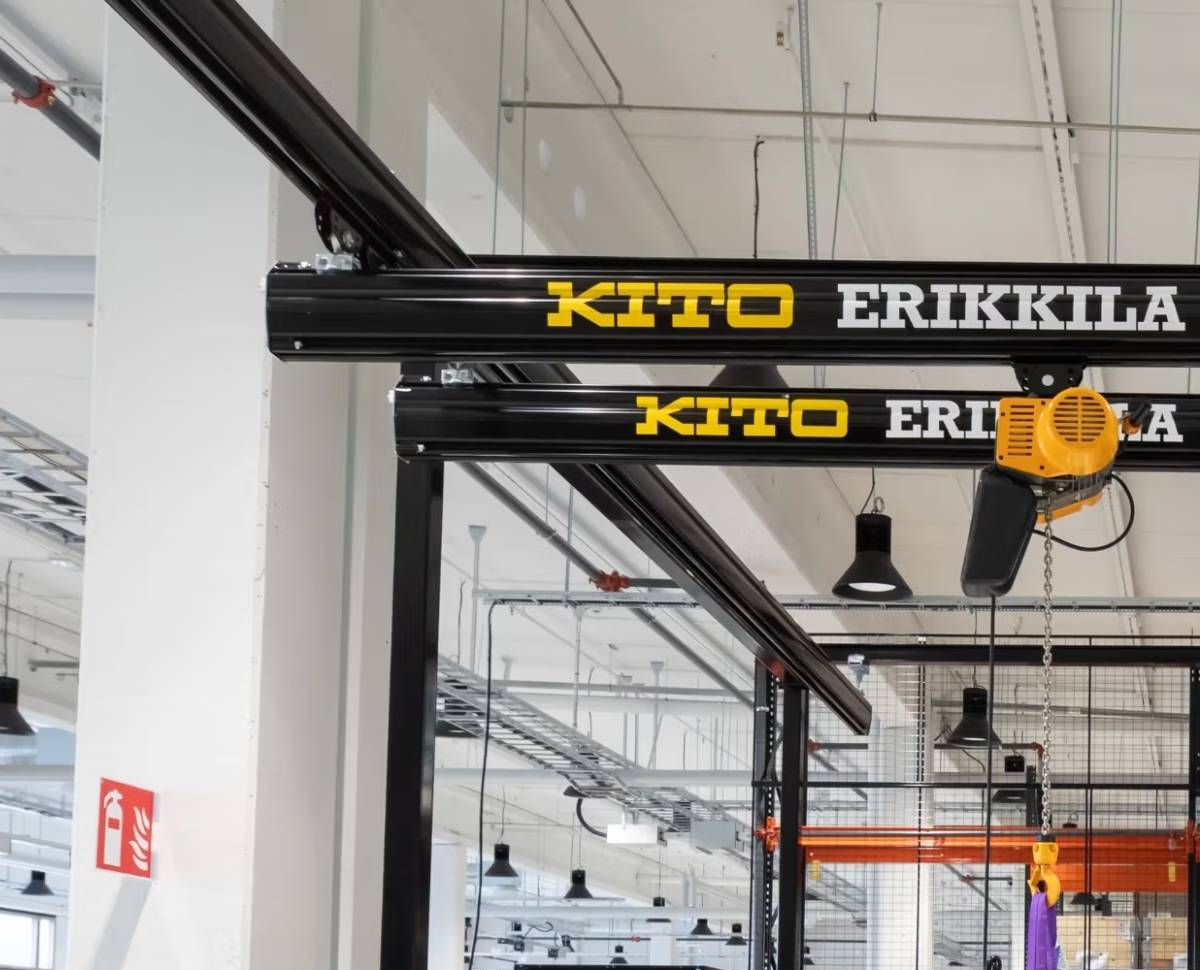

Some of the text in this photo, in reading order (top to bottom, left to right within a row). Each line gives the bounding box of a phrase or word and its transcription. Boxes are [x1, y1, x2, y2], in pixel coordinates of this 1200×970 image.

[546, 281, 795, 329] KITO
[836, 283, 1186, 331] ERIKKILA
[635, 396, 849, 438] KITO
